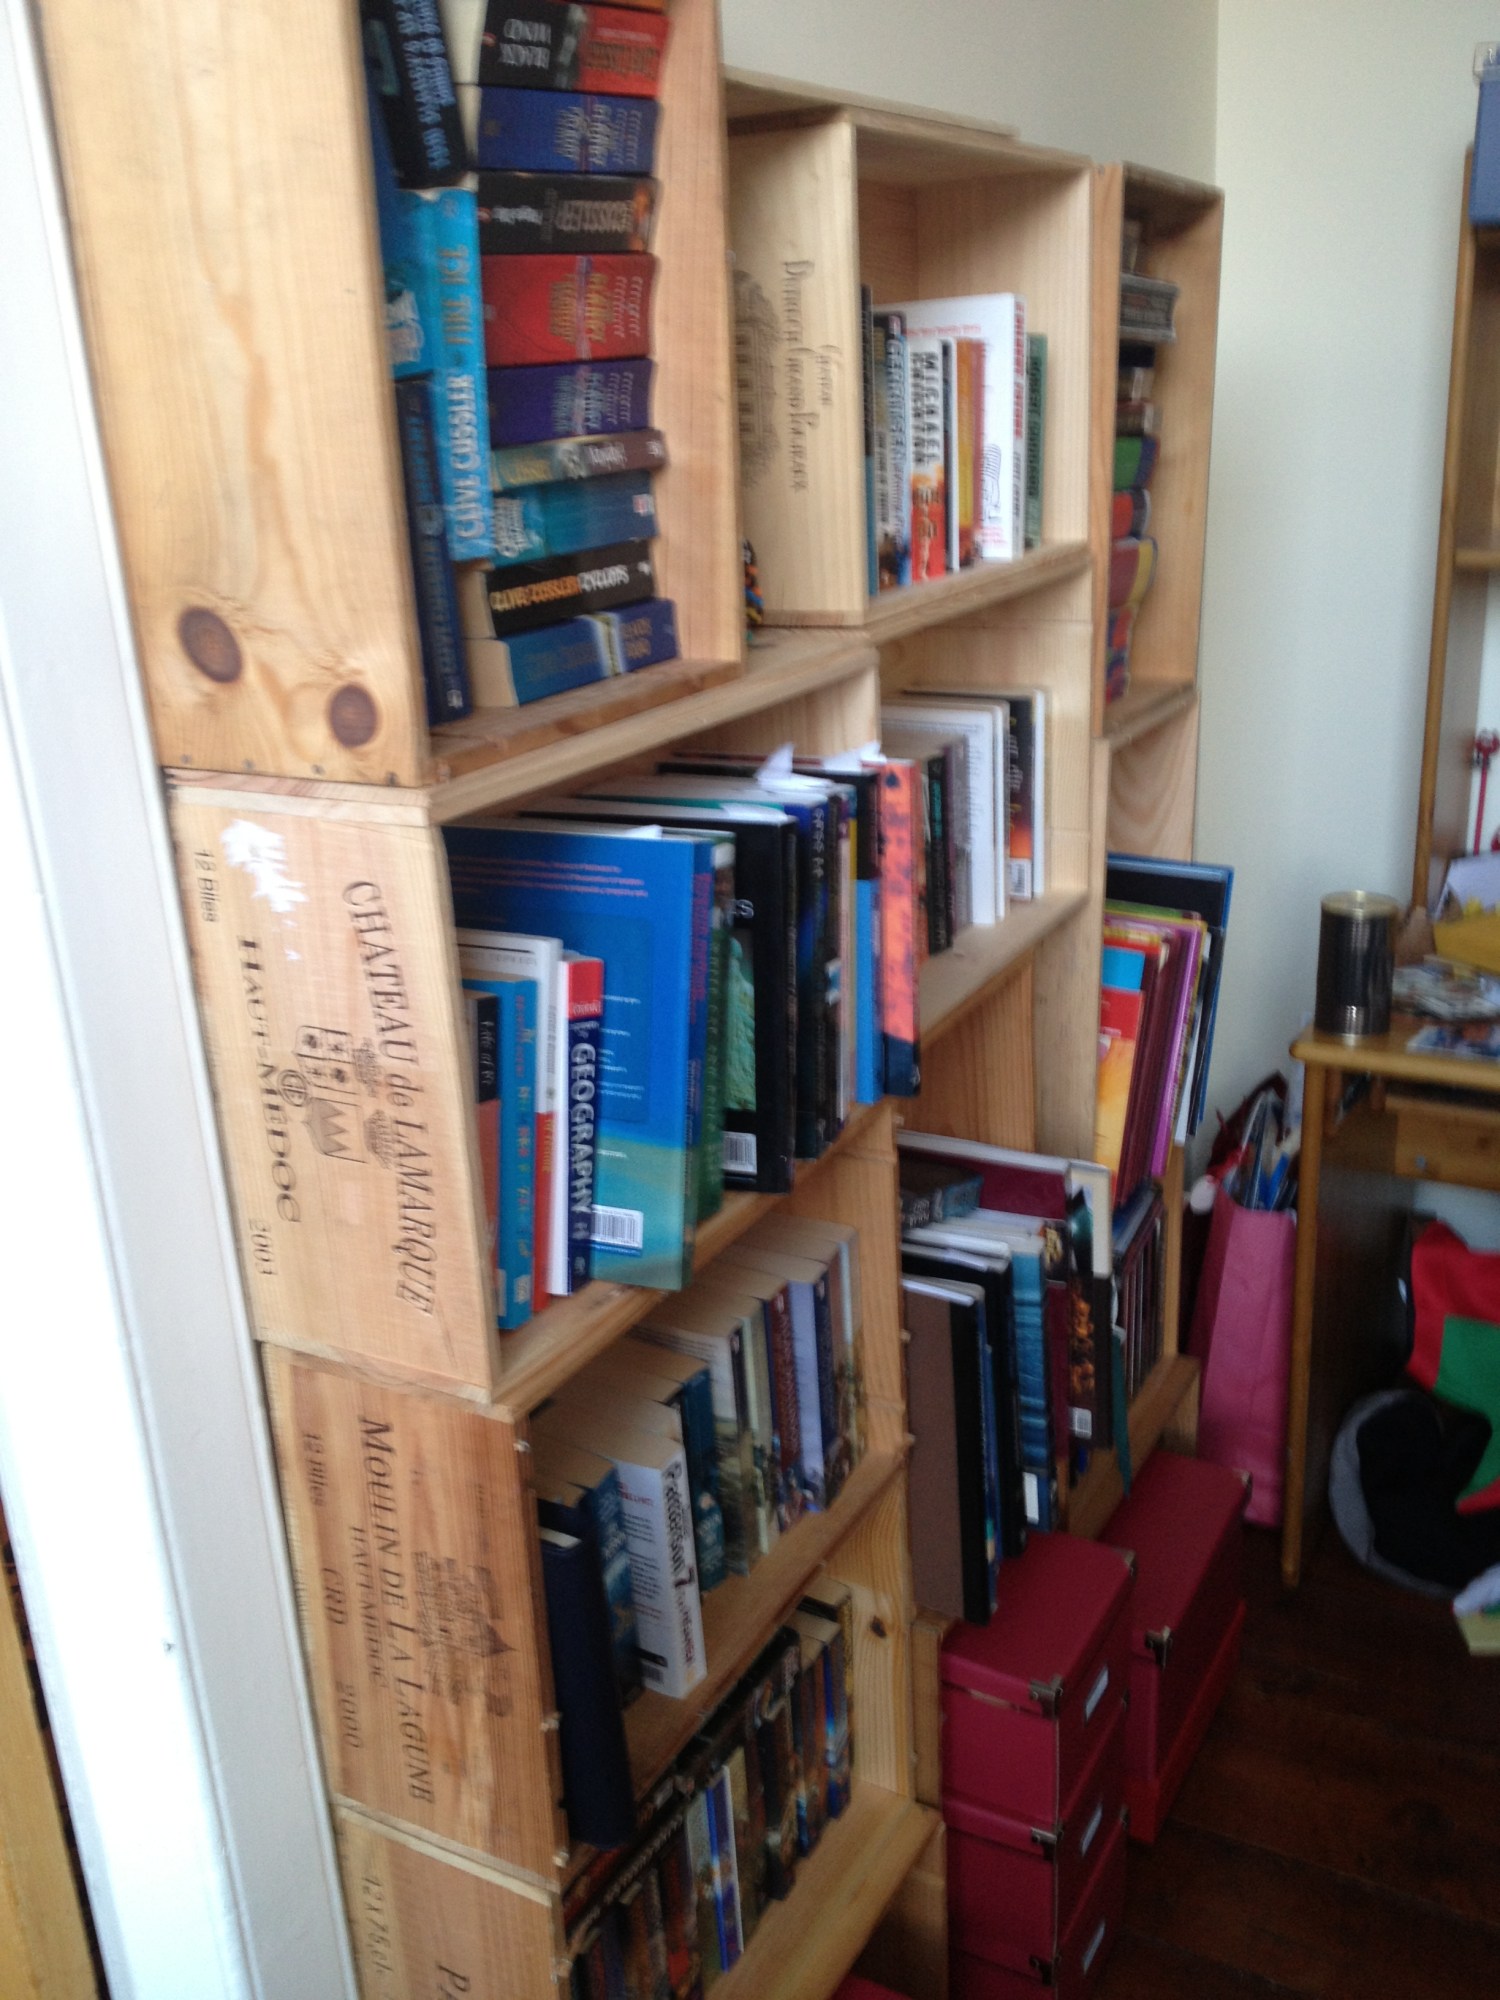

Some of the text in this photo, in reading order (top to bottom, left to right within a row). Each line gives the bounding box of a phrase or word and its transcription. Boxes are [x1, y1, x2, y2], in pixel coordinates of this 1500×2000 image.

[437, 245, 474, 347] FIRE ICE
[446, 374, 486, 540] CLIVE CUSSLER
[925, 350, 942, 464] MICHAEL
[193, 847, 216, 876] 12
[341, 879, 440, 1317] CHATEAU de LAMARQUE
[482, 1019, 496, 1049] Life
[570, 1042, 598, 1216] GEOGRAPHY
[358, 1413, 436, 1804] MOULIN DE LA LAGUNE
